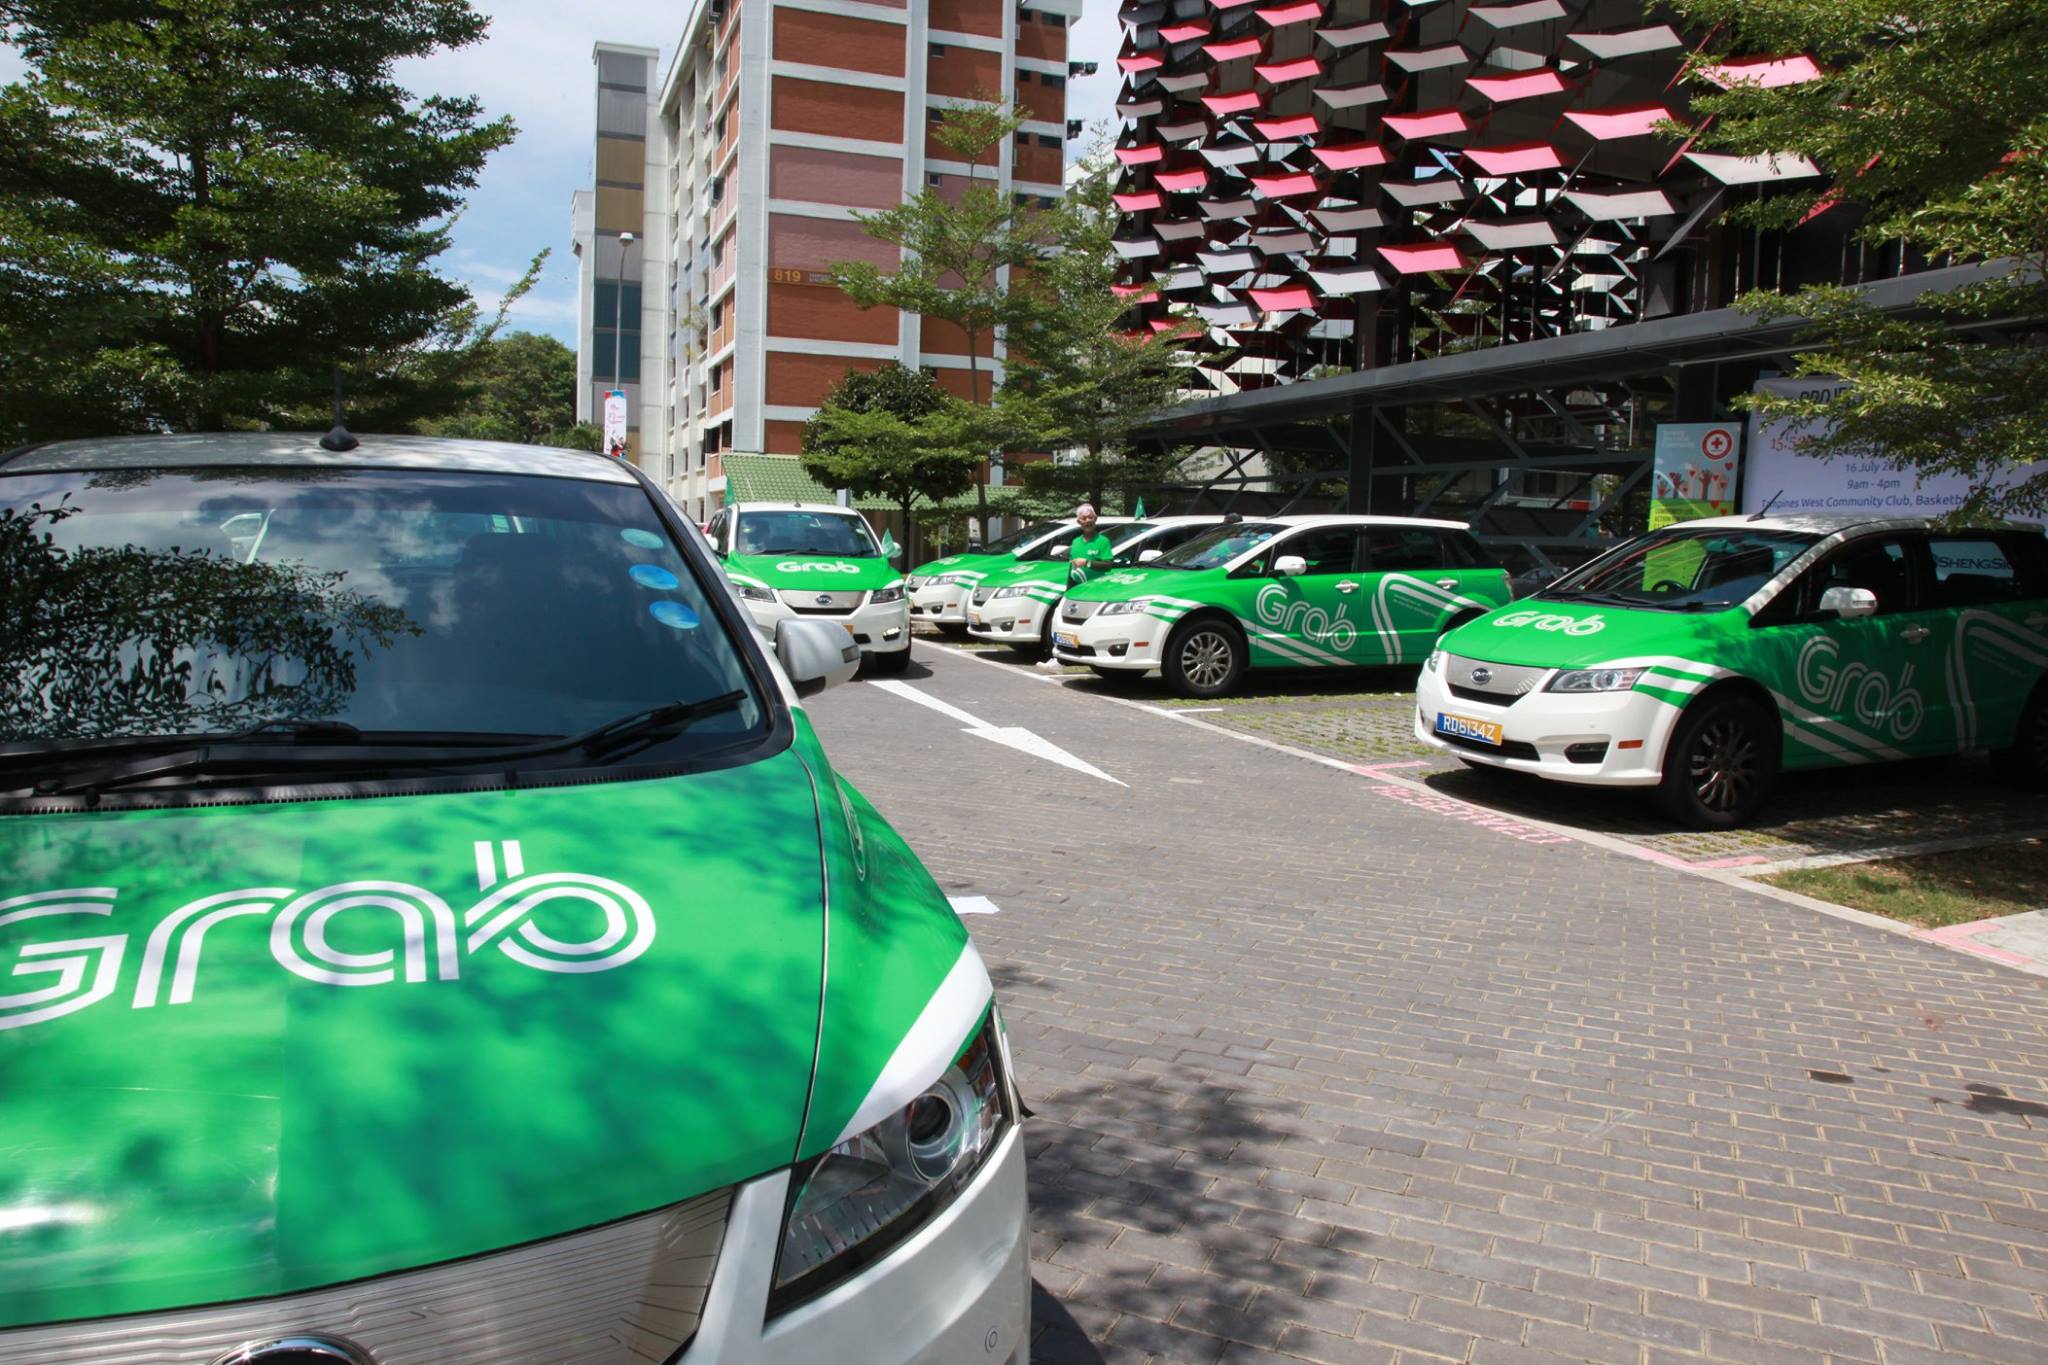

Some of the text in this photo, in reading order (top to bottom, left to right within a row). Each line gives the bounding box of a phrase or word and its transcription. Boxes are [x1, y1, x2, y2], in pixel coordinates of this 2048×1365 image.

[774, 270, 801, 282] 819
[1846, 460, 1909, 474] 16 July 26
[1848, 479, 1869, 490] 9am
[1877, 479, 1901, 491] 4pm
[1801, 498, 1824, 508] West
[1826, 496, 1883, 509] Community
[1885, 495, 1913, 507] Club,
[1916, 494, 1967, 506] Basketb
[776, 561, 861, 575] Grab
[1255, 583, 1356, 652] Grab
[1492, 610, 1606, 636] Grab
[1797, 635, 1924, 741] Grab
[1443, 715, 1496, 741] RD6134Z
[0, 839, 657, 1031] Grab
